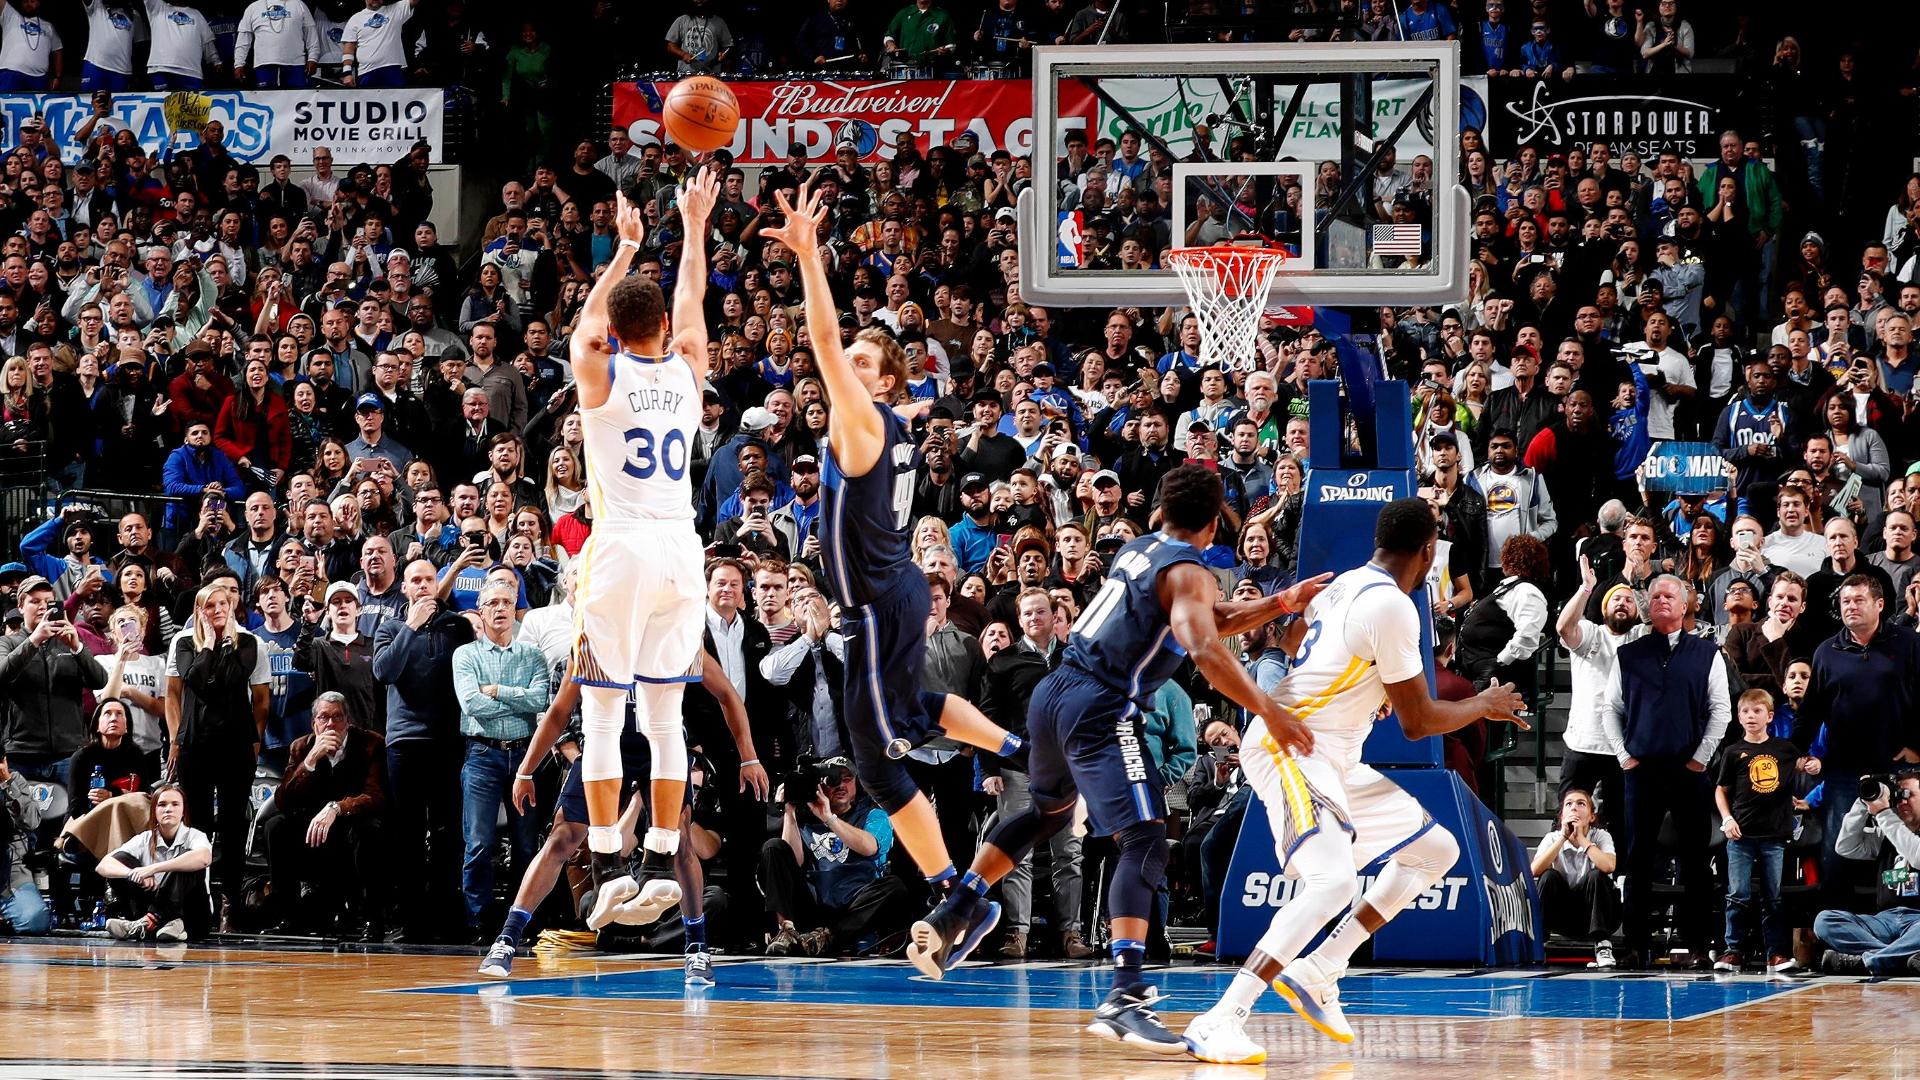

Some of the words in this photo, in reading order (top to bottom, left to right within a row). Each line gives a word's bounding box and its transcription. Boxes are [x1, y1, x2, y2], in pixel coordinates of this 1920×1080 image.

[688, 82, 737, 107] SPALDING
[765, 81, 955, 117] Budweiser
[293, 101, 428, 125] STUDIO
[1325, 98, 1407, 117] CRT
[1566, 110, 1710, 136] STARPOWER
[293, 127, 360, 141] MOVIE
[368, 127, 427, 141] GRILL
[1637, 140, 1696, 155] SEATS
[1060, 254, 1076, 265] NBA
[627, 387, 684, 414] CURRY
[621, 427, 687, 481] 30
[1645, 455, 1668, 478] GO
[1319, 485, 1393, 503] SPALDING
[1499, 488, 1512, 498] 30
[1761, 762, 1773, 771] 30
